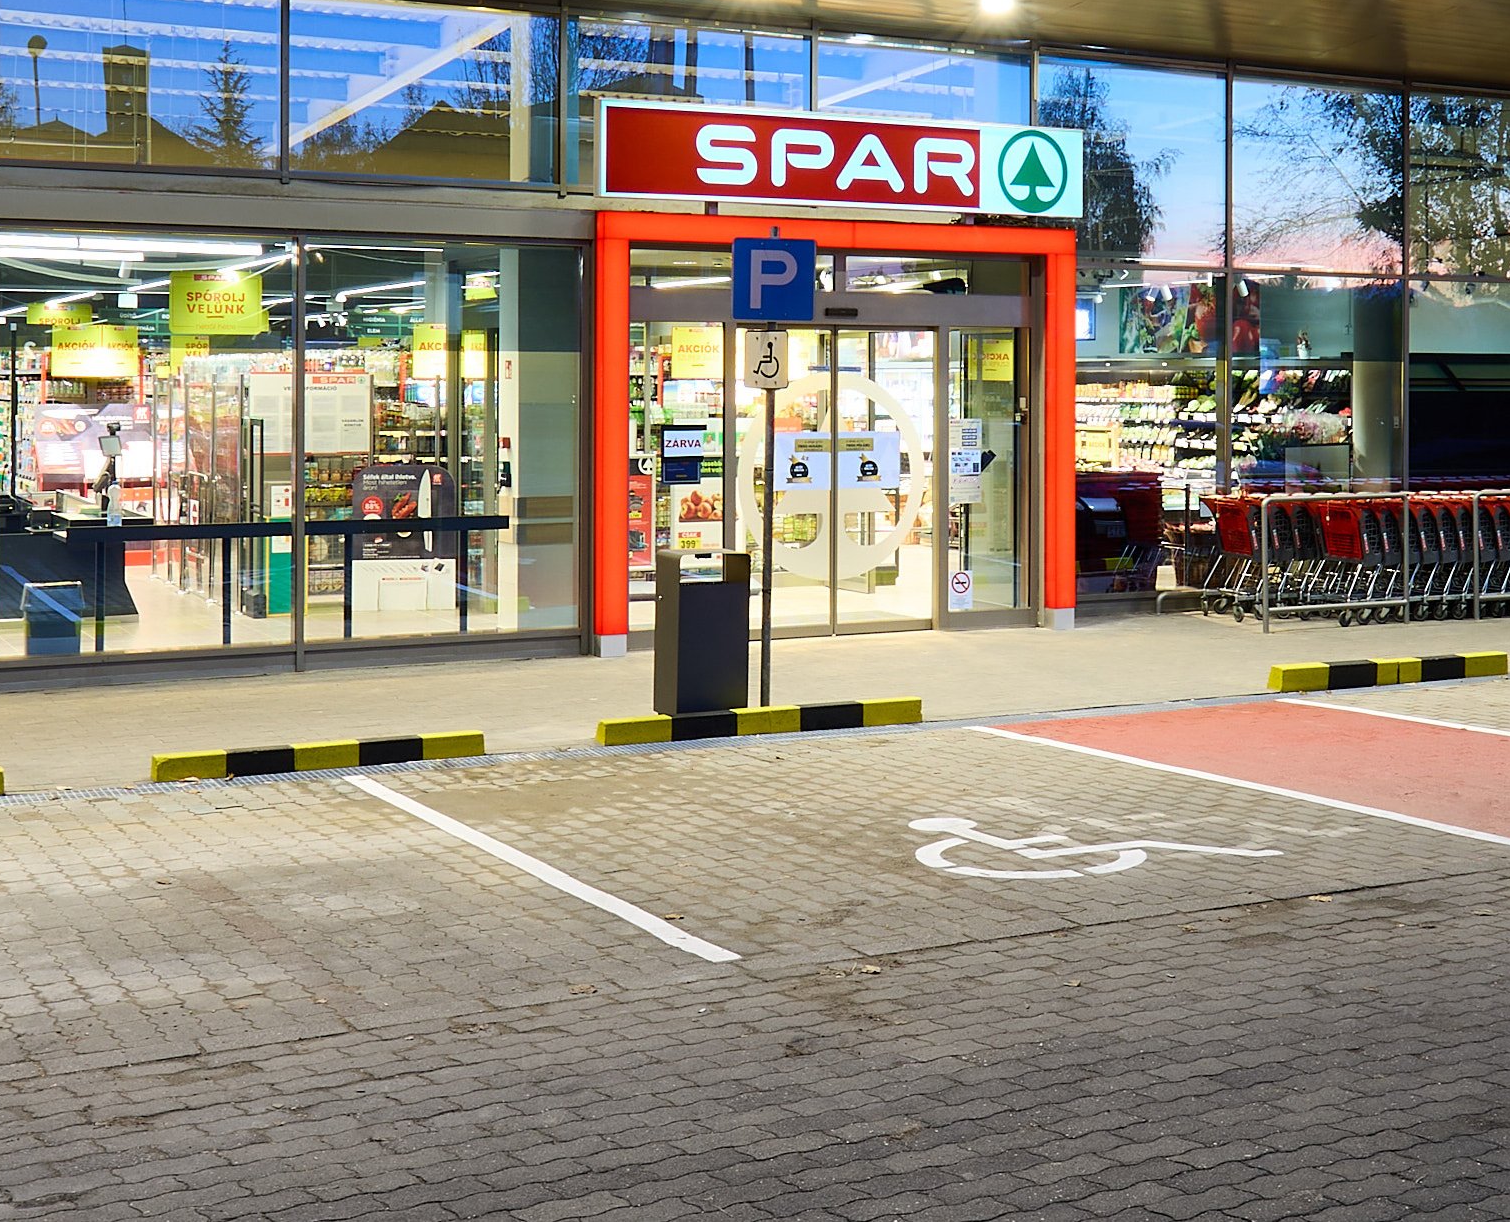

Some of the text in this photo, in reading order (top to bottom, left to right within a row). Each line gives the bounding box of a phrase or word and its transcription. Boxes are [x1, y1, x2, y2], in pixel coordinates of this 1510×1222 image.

[696, 123, 976, 196] SPAR
[750, 249, 797, 309] P
[186, 289, 246, 302] SPÓROLJ
[186, 302, 245, 313] VELÜNK
[57, 340, 95, 350] AKCIÓK
[678, 341, 720, 353] AKCIÓK
[665, 437, 701, 448] ZÁRVA
[680, 540, 696, 549] 399
